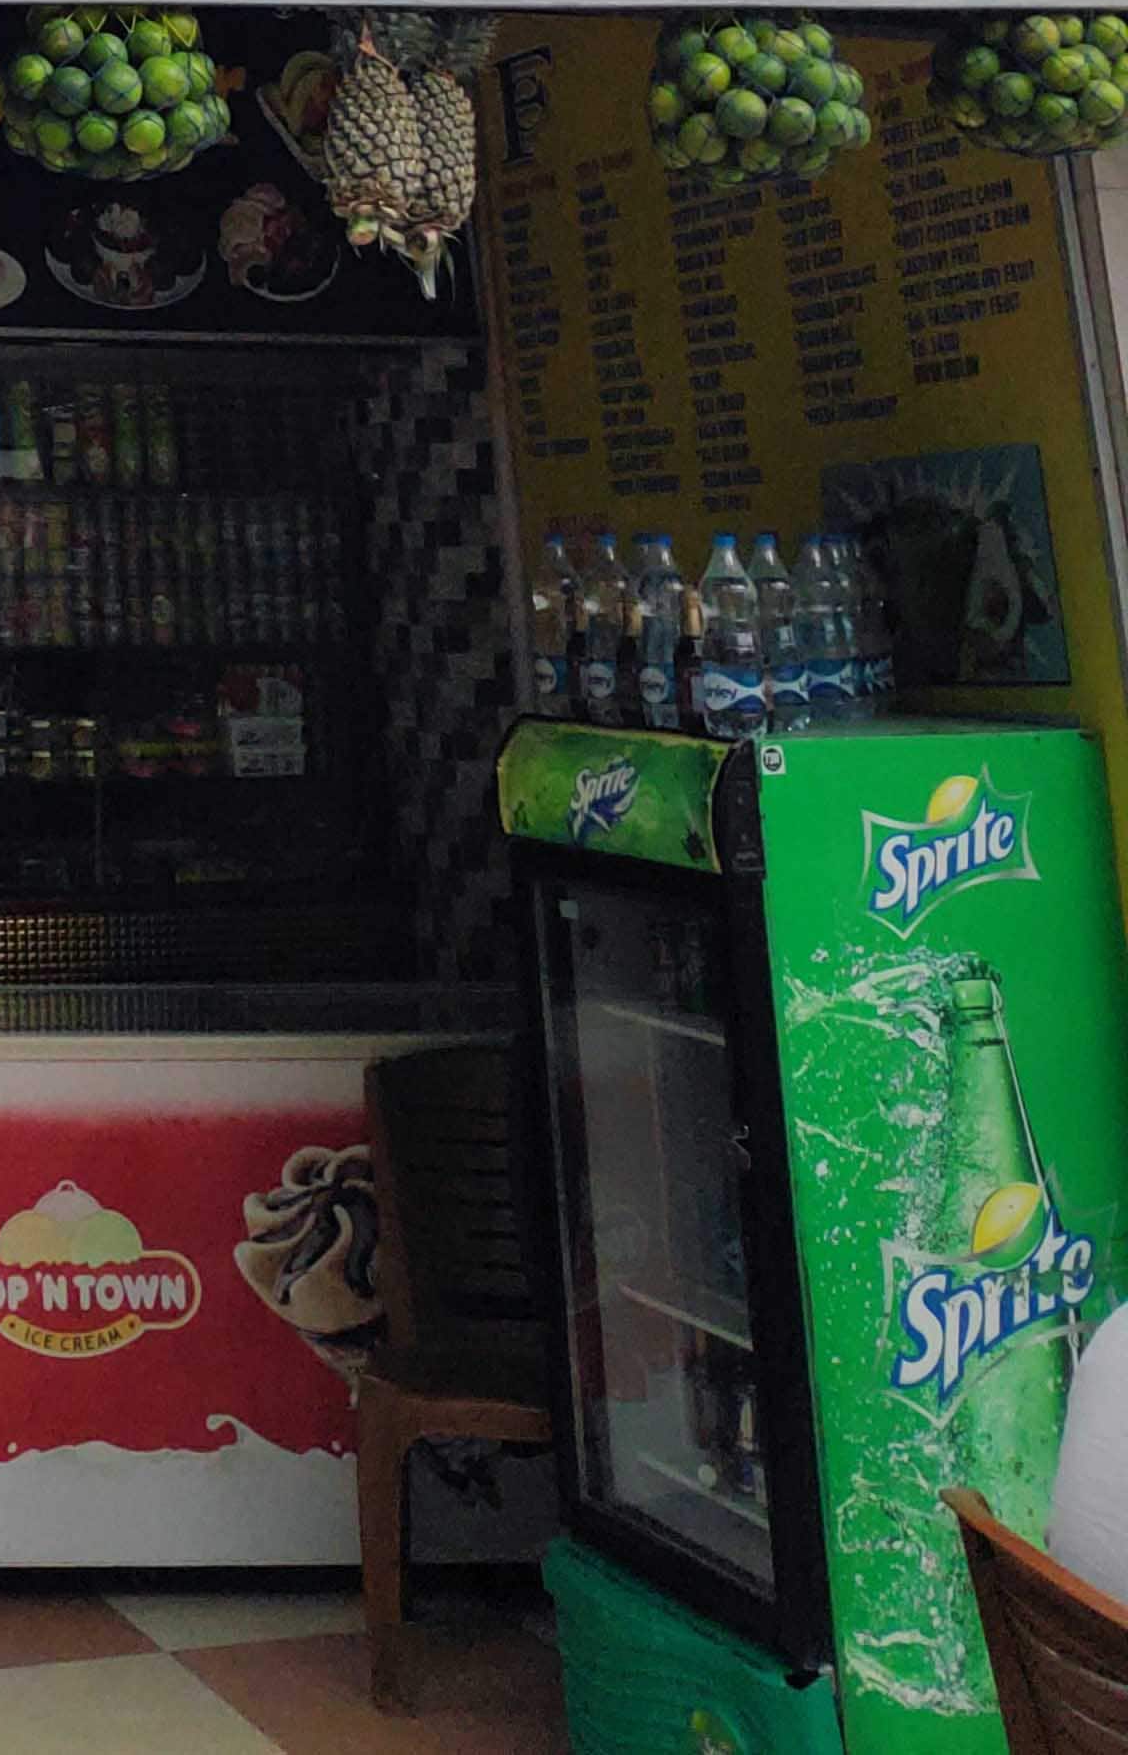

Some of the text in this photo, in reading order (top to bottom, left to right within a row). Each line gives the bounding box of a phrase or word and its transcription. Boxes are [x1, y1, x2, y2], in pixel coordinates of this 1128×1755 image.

[570, 764, 636, 819] Sprite
[871, 793, 1017, 921] Sprite
[73, 1274, 187, 1312] TOWN
[892, 1205, 1095, 1402] Sprite
[23, 1326, 123, 1353] ICE CREAM
